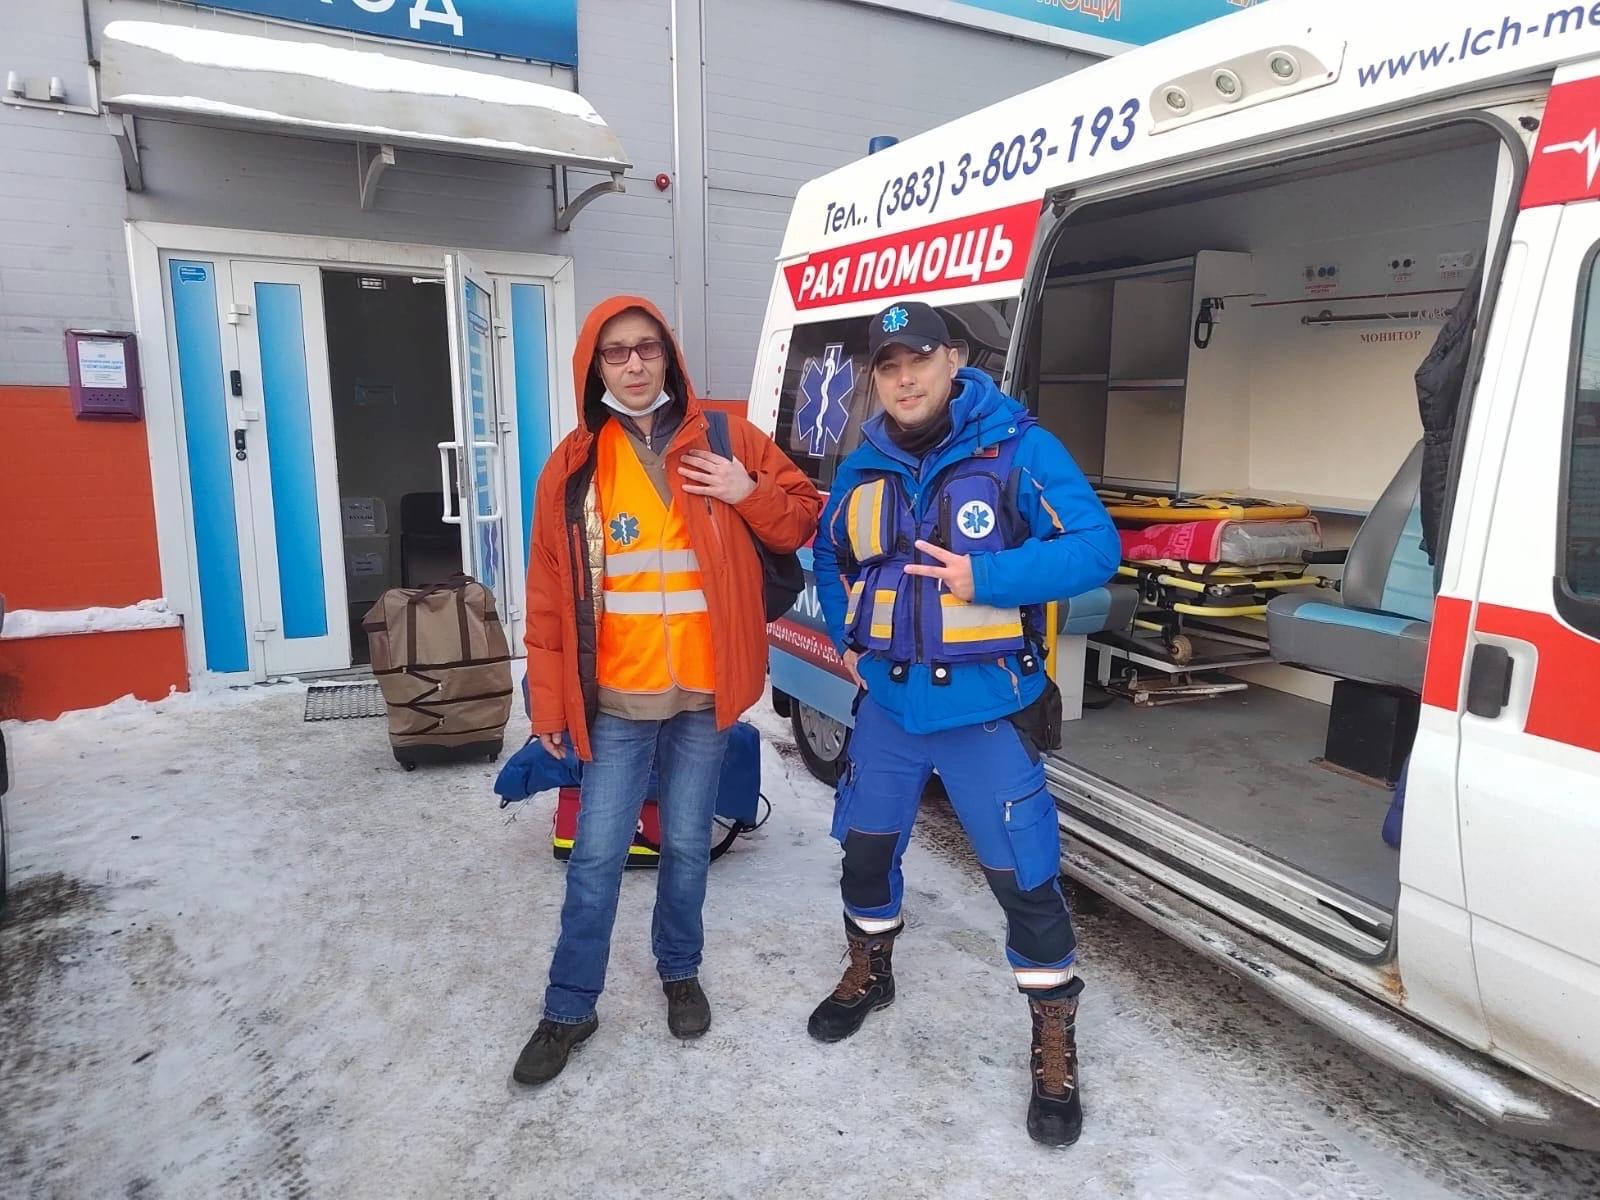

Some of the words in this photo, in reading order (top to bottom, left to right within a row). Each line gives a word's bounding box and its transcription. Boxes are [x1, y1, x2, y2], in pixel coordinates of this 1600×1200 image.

[877, 161, 945, 228] (383)
[951, 98, 1140, 196] 3-803-193
[798, 257, 851, 302] РАЯ
[852, 224, 1014, 294] ПОМОЩЬ
[1360, 330, 1421, 344] МОНИТОР
